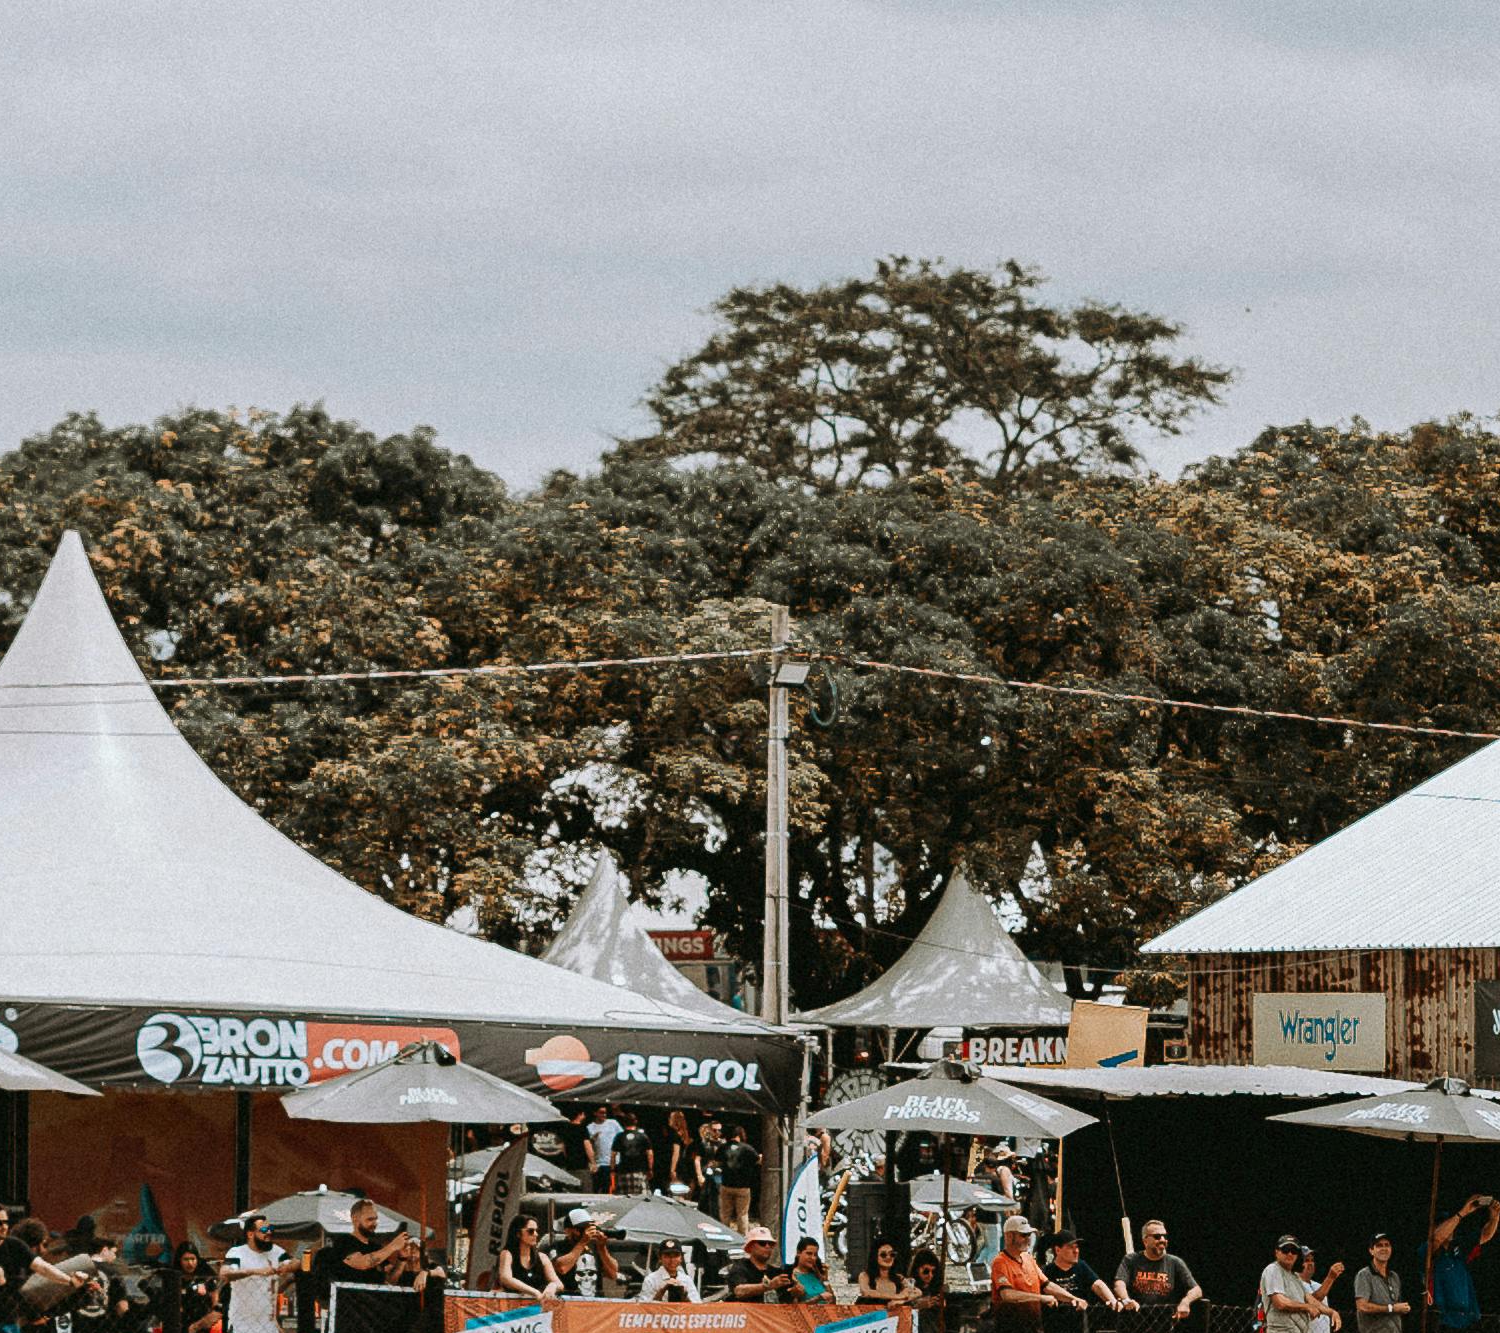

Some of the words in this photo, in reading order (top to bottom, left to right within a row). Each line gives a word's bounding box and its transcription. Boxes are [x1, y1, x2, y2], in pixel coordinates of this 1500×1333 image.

[1278, 1009, 1360, 1061] Wrangler
[201, 1056, 311, 1085] ZAUTTO
[616, 1053, 762, 1091] REPSOL
[883, 1105, 981, 1123] PRINCESS
[903, 1095, 970, 1112] BLACK
[619, 1312, 687, 1329] TEMPEROS
[688, 1313, 747, 1329] ESPECIAIS
